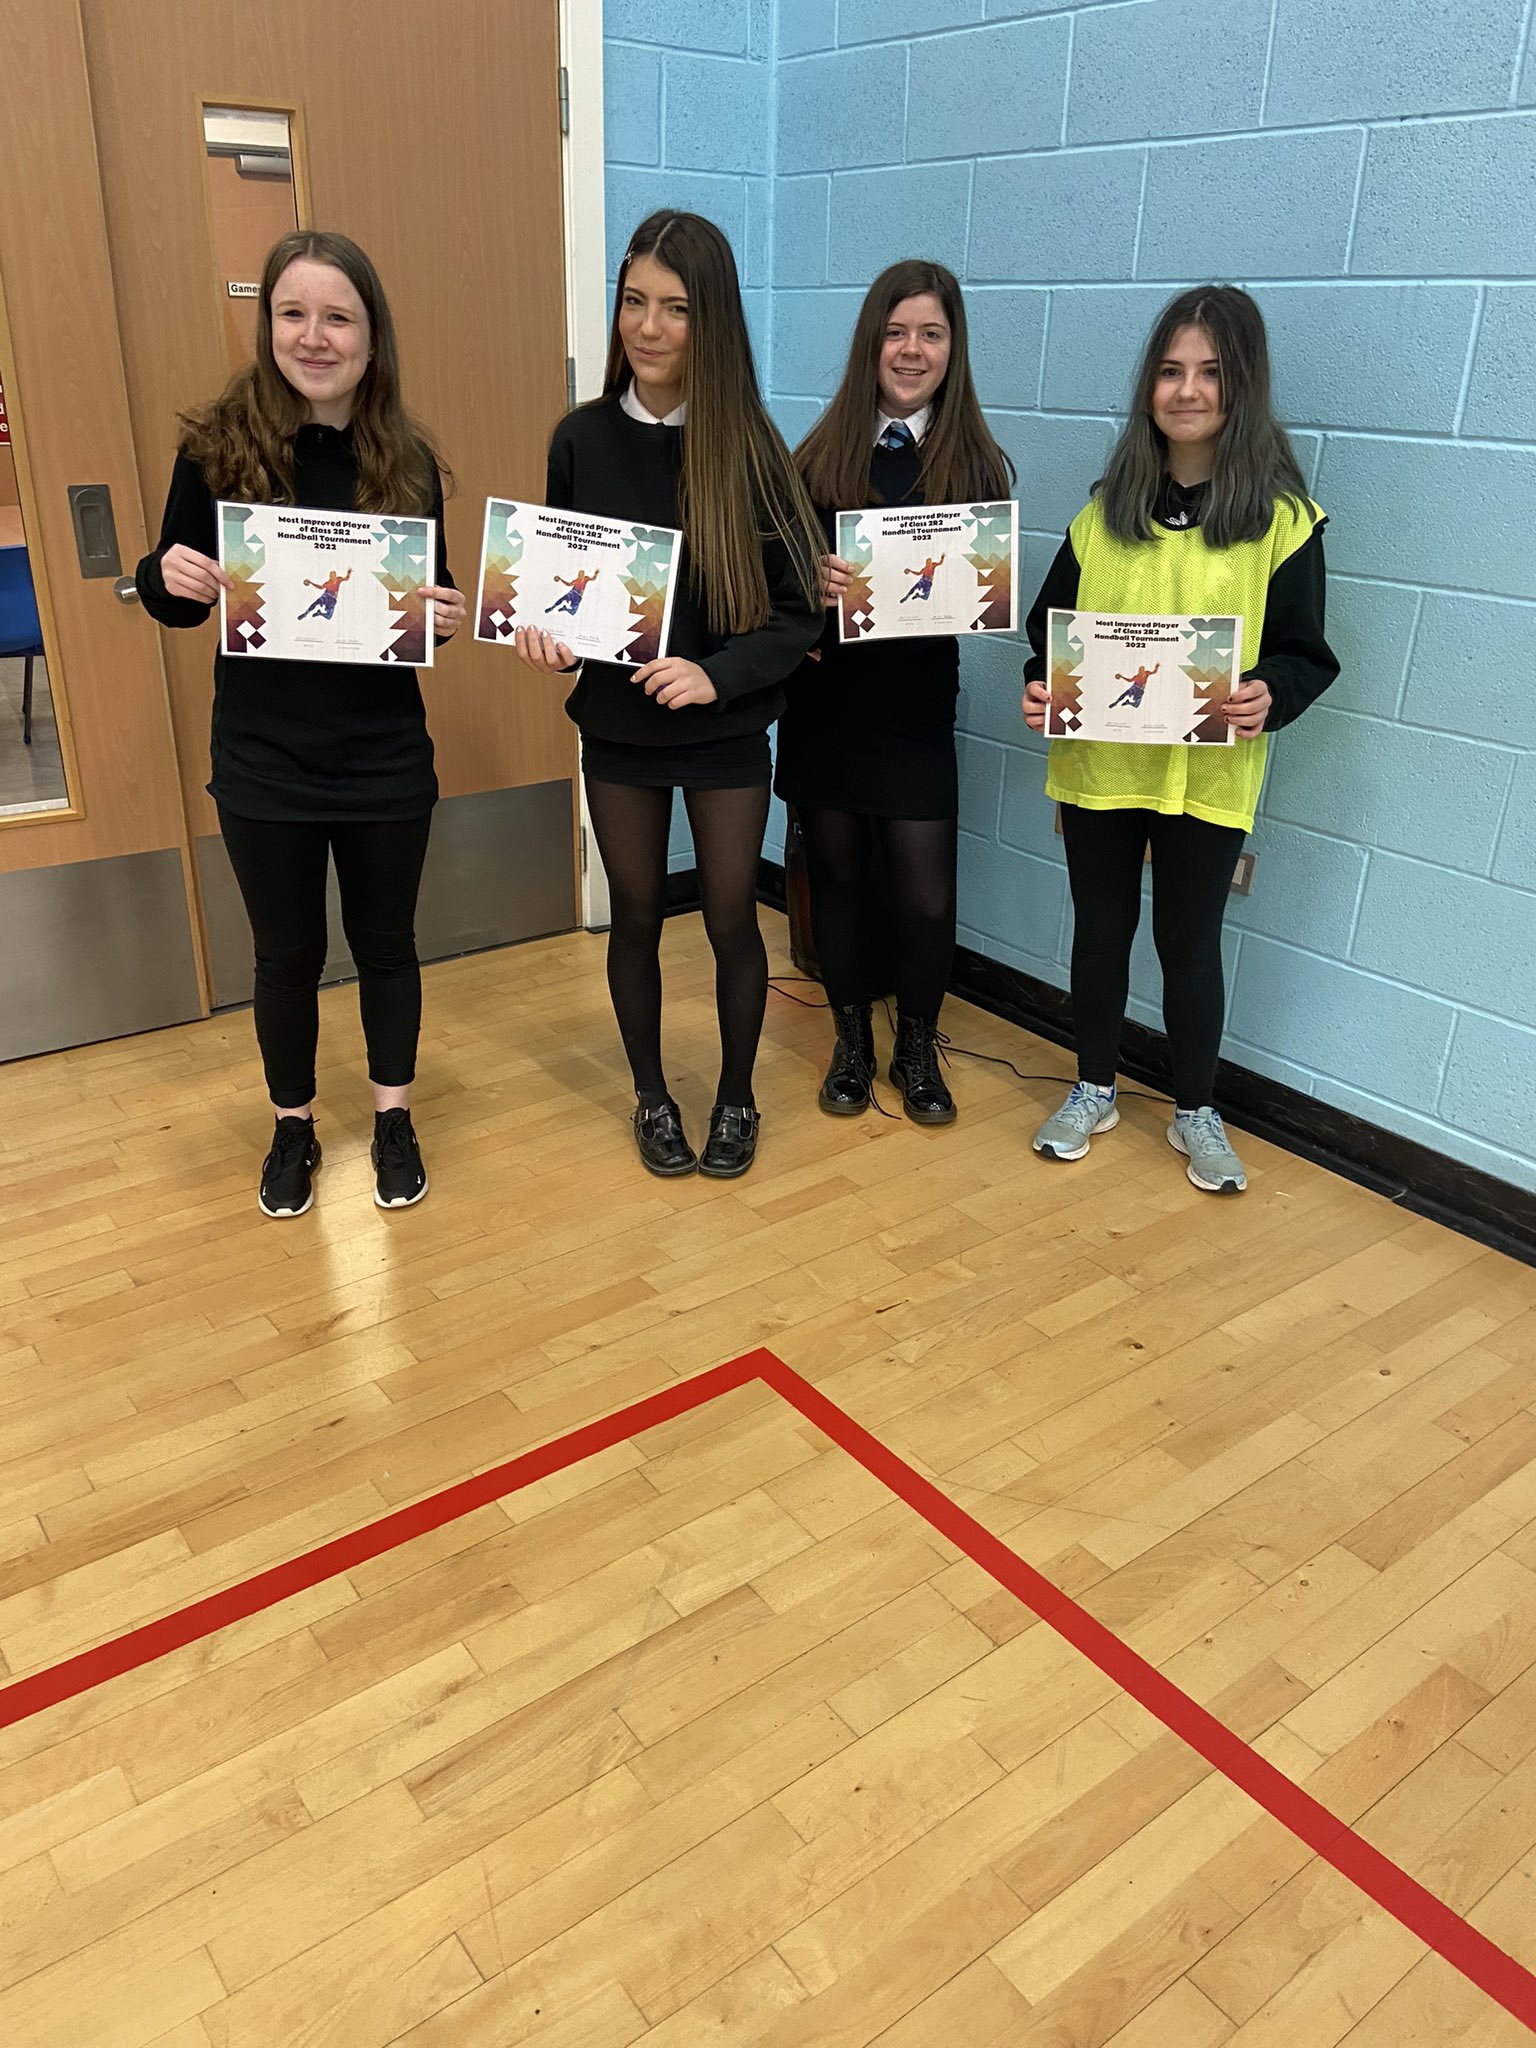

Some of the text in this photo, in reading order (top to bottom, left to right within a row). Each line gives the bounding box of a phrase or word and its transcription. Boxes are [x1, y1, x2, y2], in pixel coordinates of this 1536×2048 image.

[230, 284, 260, 294] Game
[901, 513, 935, 521] Improved
[278, 516, 371, 530] Most Improved Player
[538, 515, 621, 534] Most Improved Player
[310, 526, 331, 534] Class
[333, 528, 351, 536] 2R2
[565, 527, 585, 535] Class
[586, 530, 602, 539] 2R2
[917, 525, 962, 534] Tournament
[277, 532, 371, 545] Handball Tournament
[536, 529, 620, 549] Handball Tournament
[567, 542, 588, 551] 2022
[1094, 633, 1129, 641] Handball
